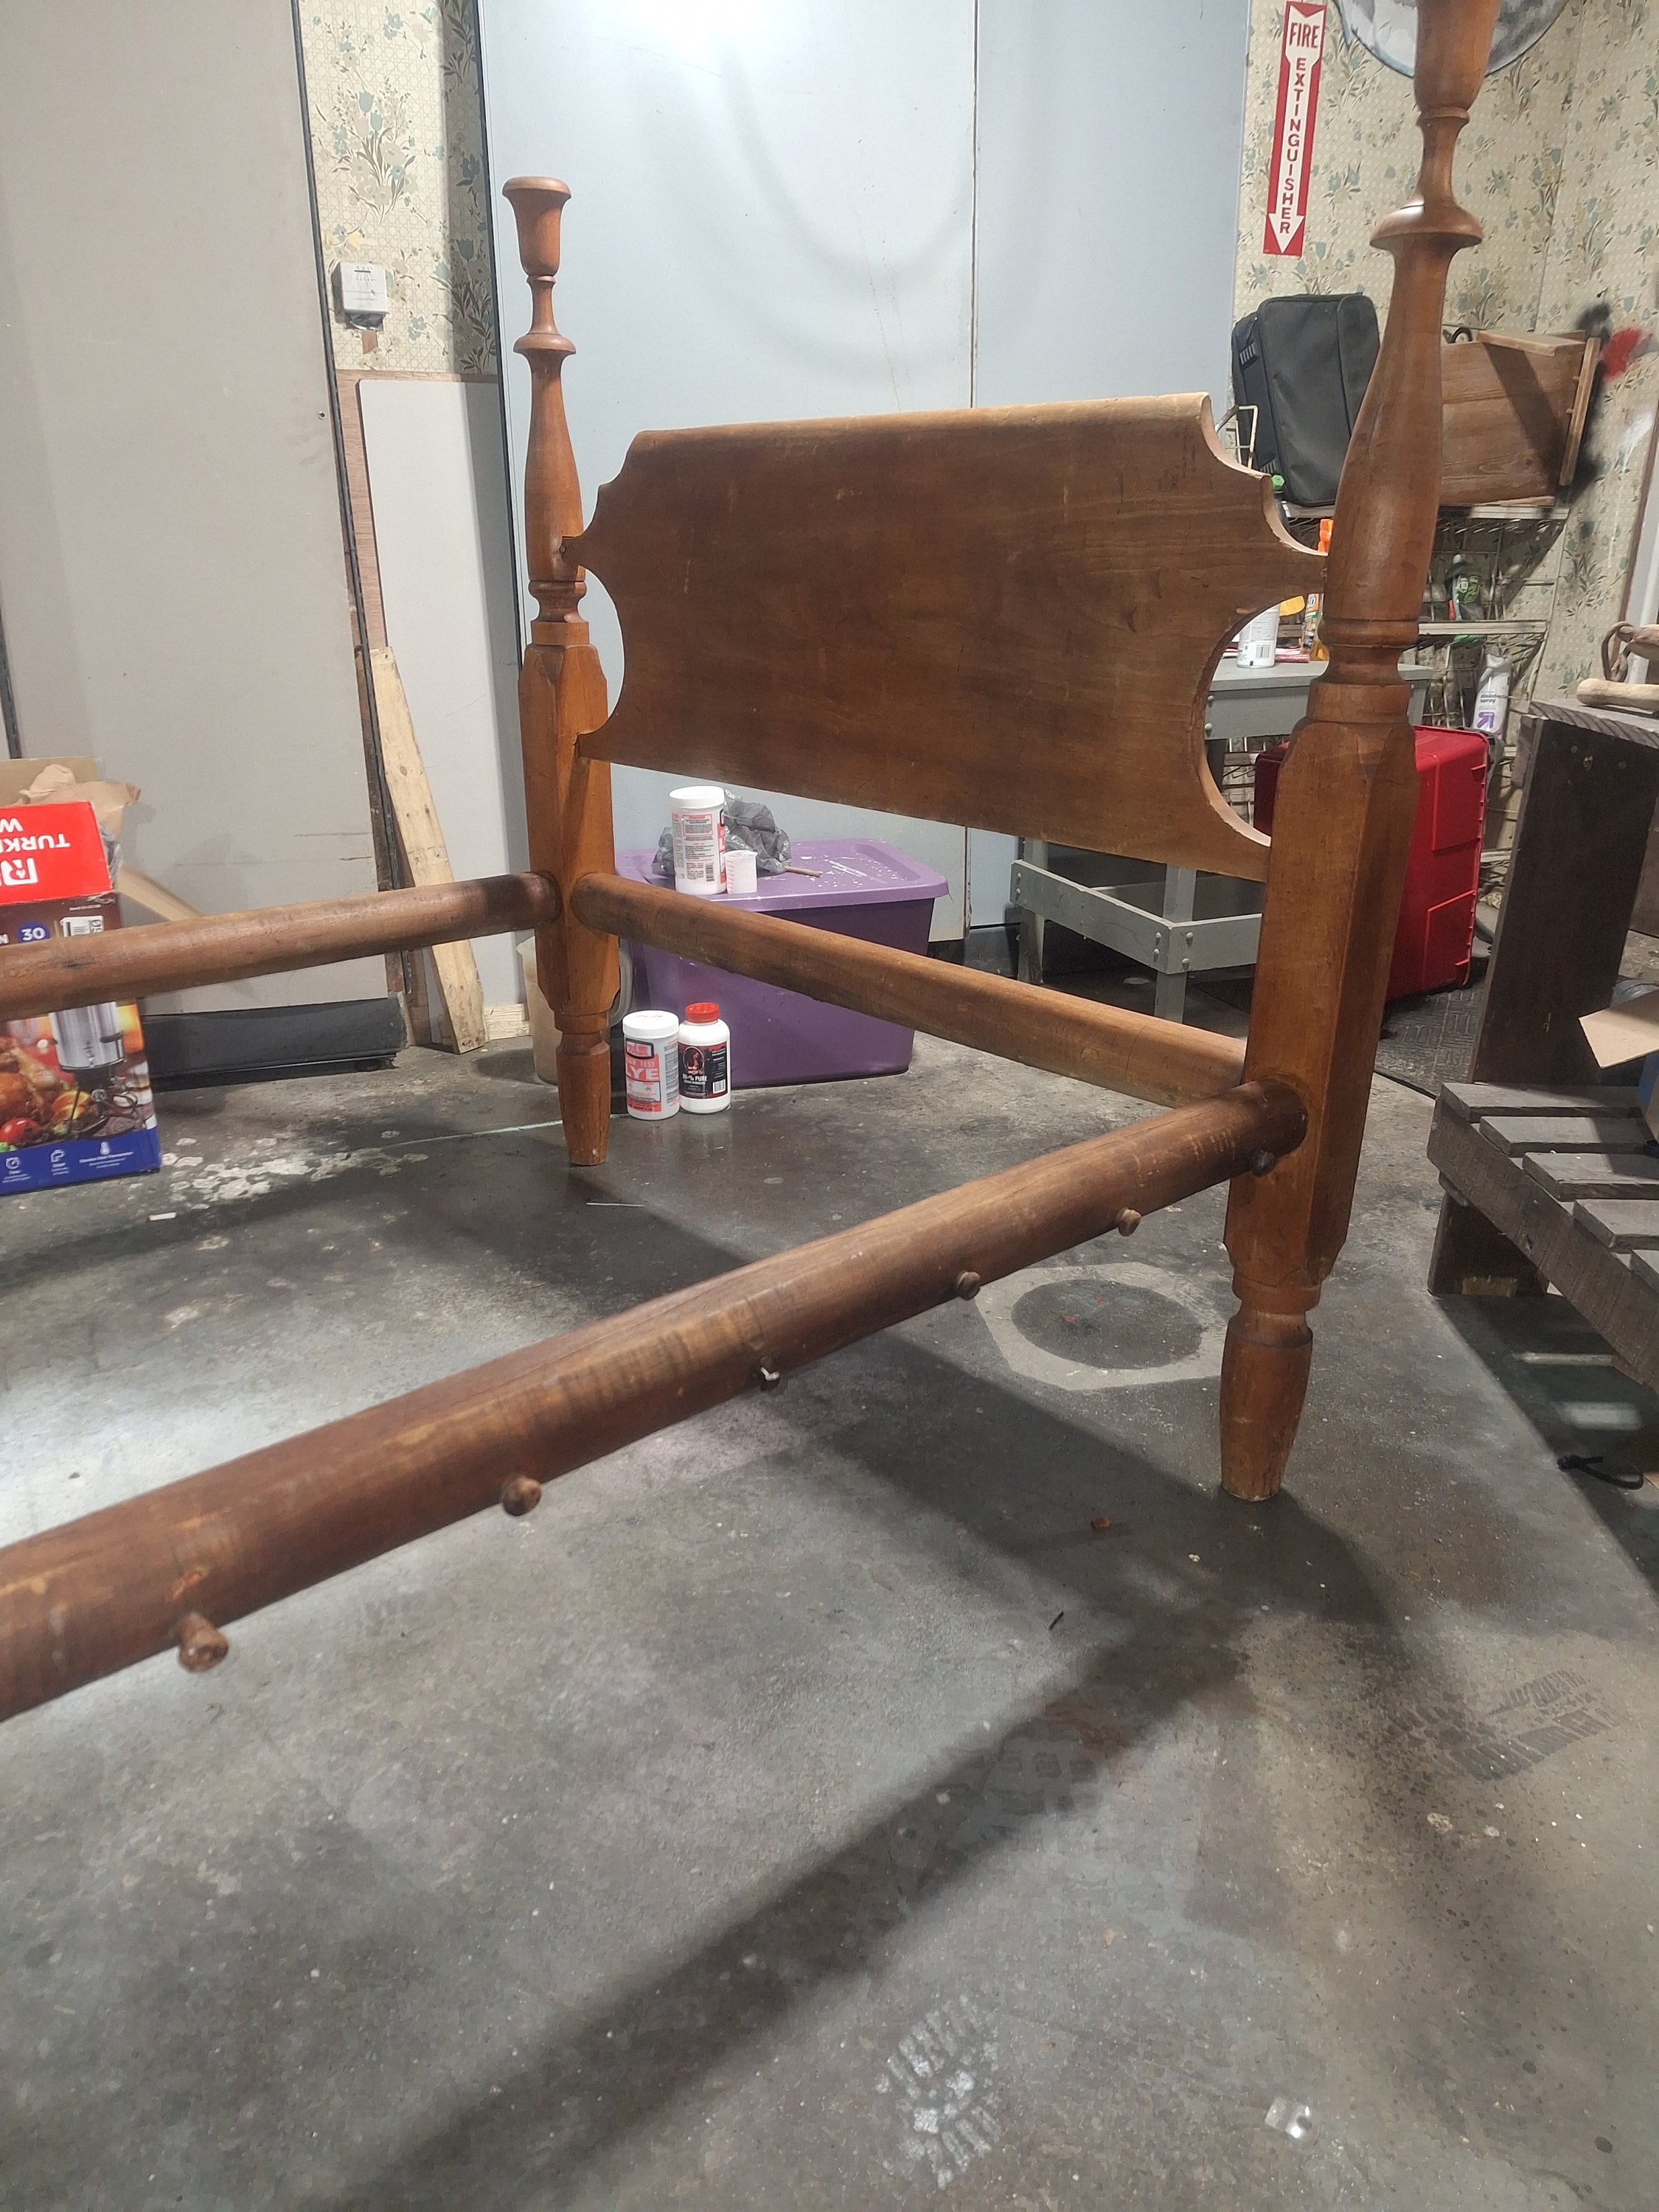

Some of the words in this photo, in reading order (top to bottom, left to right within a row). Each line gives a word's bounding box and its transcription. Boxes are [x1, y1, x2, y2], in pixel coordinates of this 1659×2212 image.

[1289, 22, 1320, 48] FIRE
[1280, 57, 1307, 234] EXTINGUISHER
[21, 927, 46, 942] 30
[626, 1066, 659, 1082] LYE
